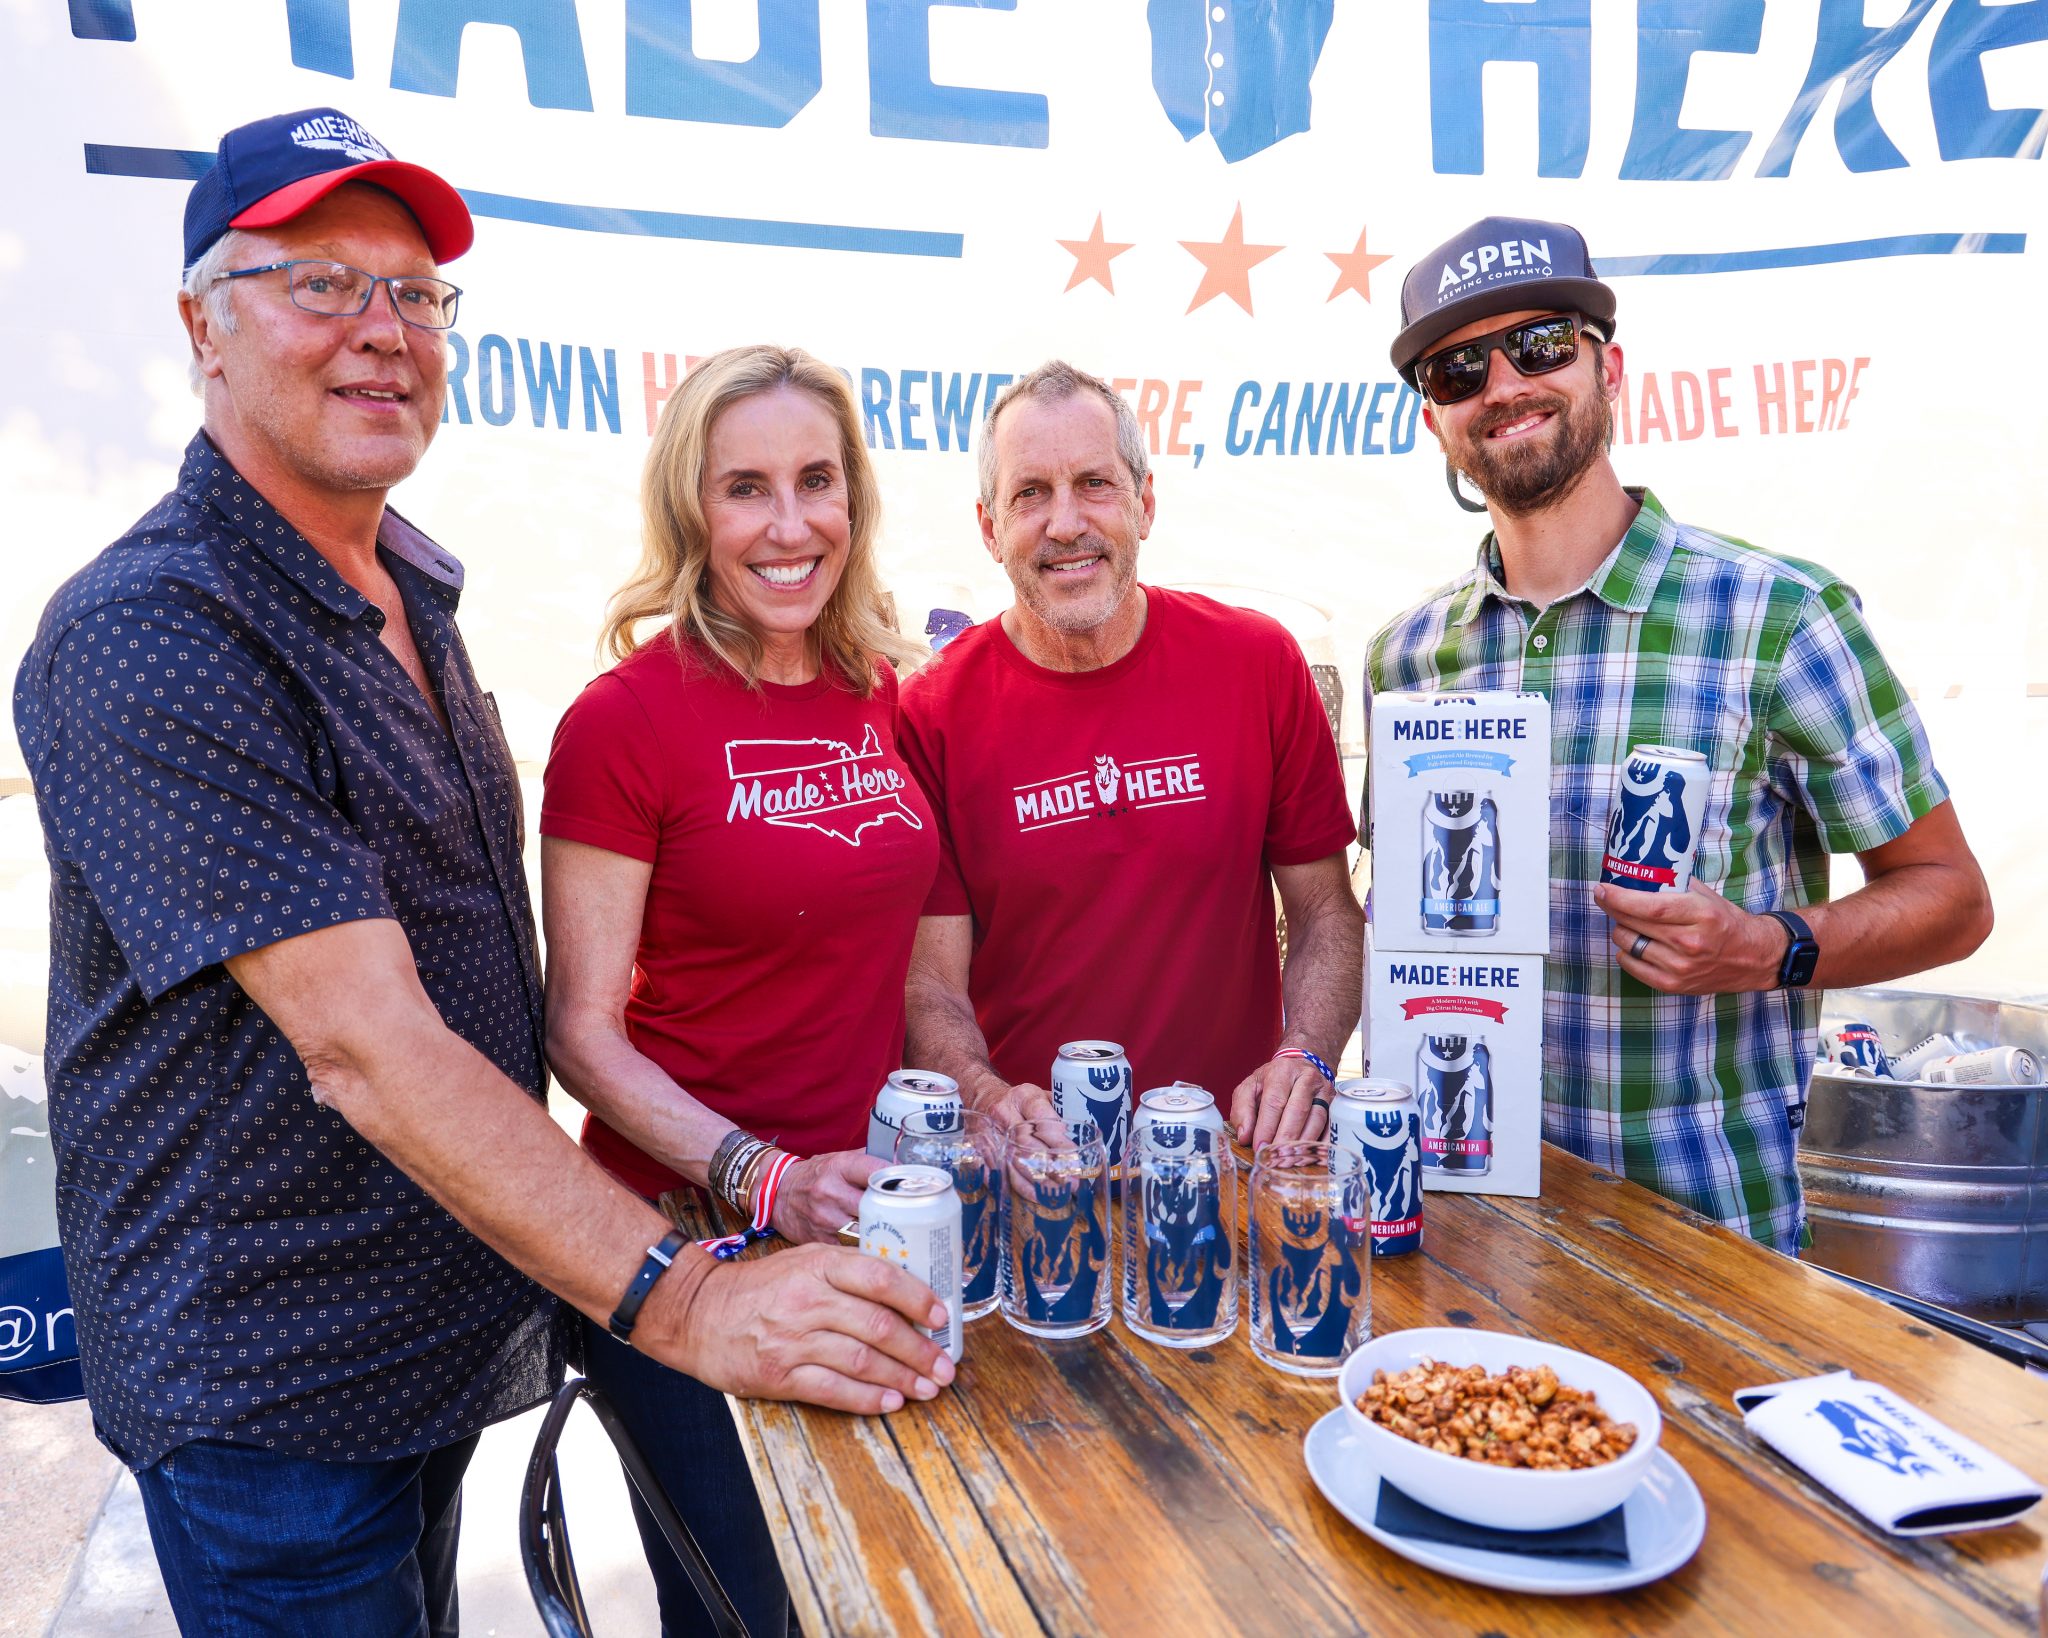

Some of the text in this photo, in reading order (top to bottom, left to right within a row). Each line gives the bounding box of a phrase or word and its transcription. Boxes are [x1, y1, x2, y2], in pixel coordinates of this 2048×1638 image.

[291, 116, 342, 144] MADE
[1437, 239, 1552, 294] ASPEN
[1438, 267, 1540, 304] BREWING COMPANY
[441, 331, 622, 434] ROWN
[1752, 356, 1872, 435] HERE
[1393, 718, 1527, 741] MADE HERE
[726, 762, 906, 824] Made Here
[1014, 762, 1205, 824] MADE HERE
[1606, 859, 1654, 879] AMERICAN IPA
[1433, 902, 1488, 913] AMERICAN ALE
[1390, 964, 1520, 988] MADE HERE
[1428, 1142, 1480, 1152] AMERICAN IPA
[1370, 1223, 1405, 1235] MERICAN
[1406, 1220, 1417, 1232] IPA
[1125, 1253, 1137, 1305] MADE
